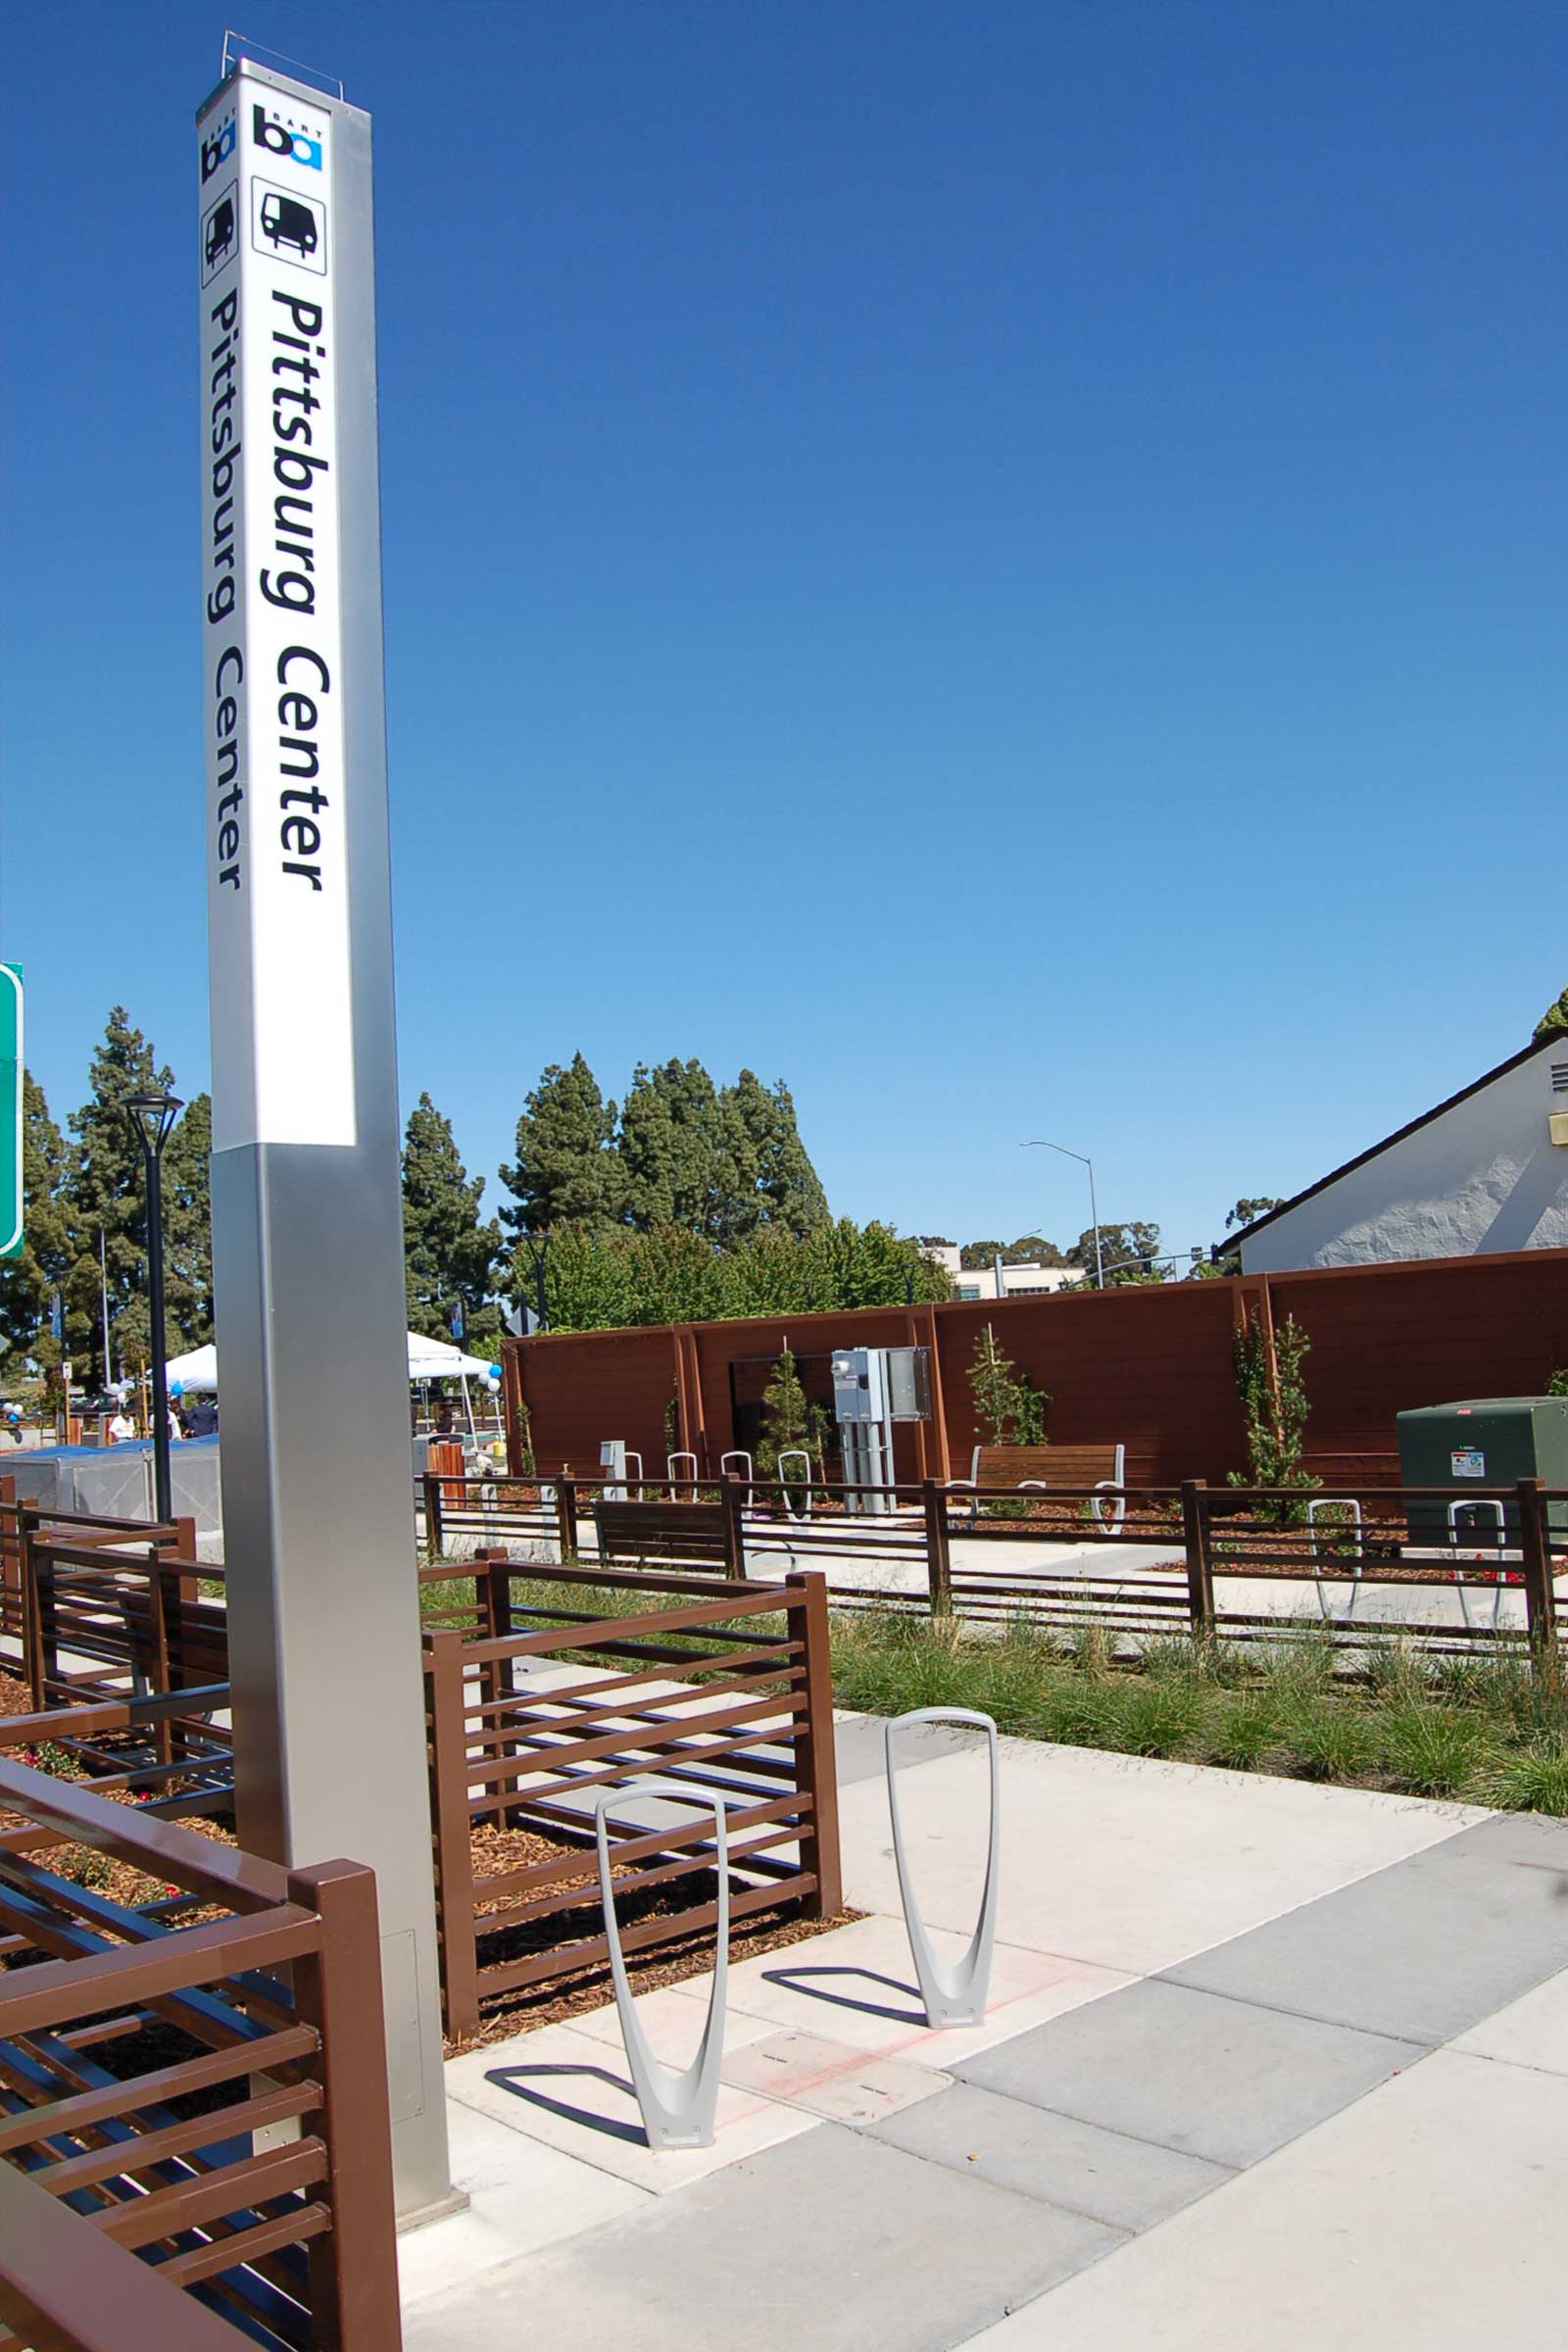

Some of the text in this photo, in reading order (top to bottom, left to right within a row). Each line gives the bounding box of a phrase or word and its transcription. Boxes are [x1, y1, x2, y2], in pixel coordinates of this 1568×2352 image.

[273, 113, 322, 139] BART
[207, 287, 243, 891] Pittsburg Center
[260, 290, 330, 891] Pittsburg Center
